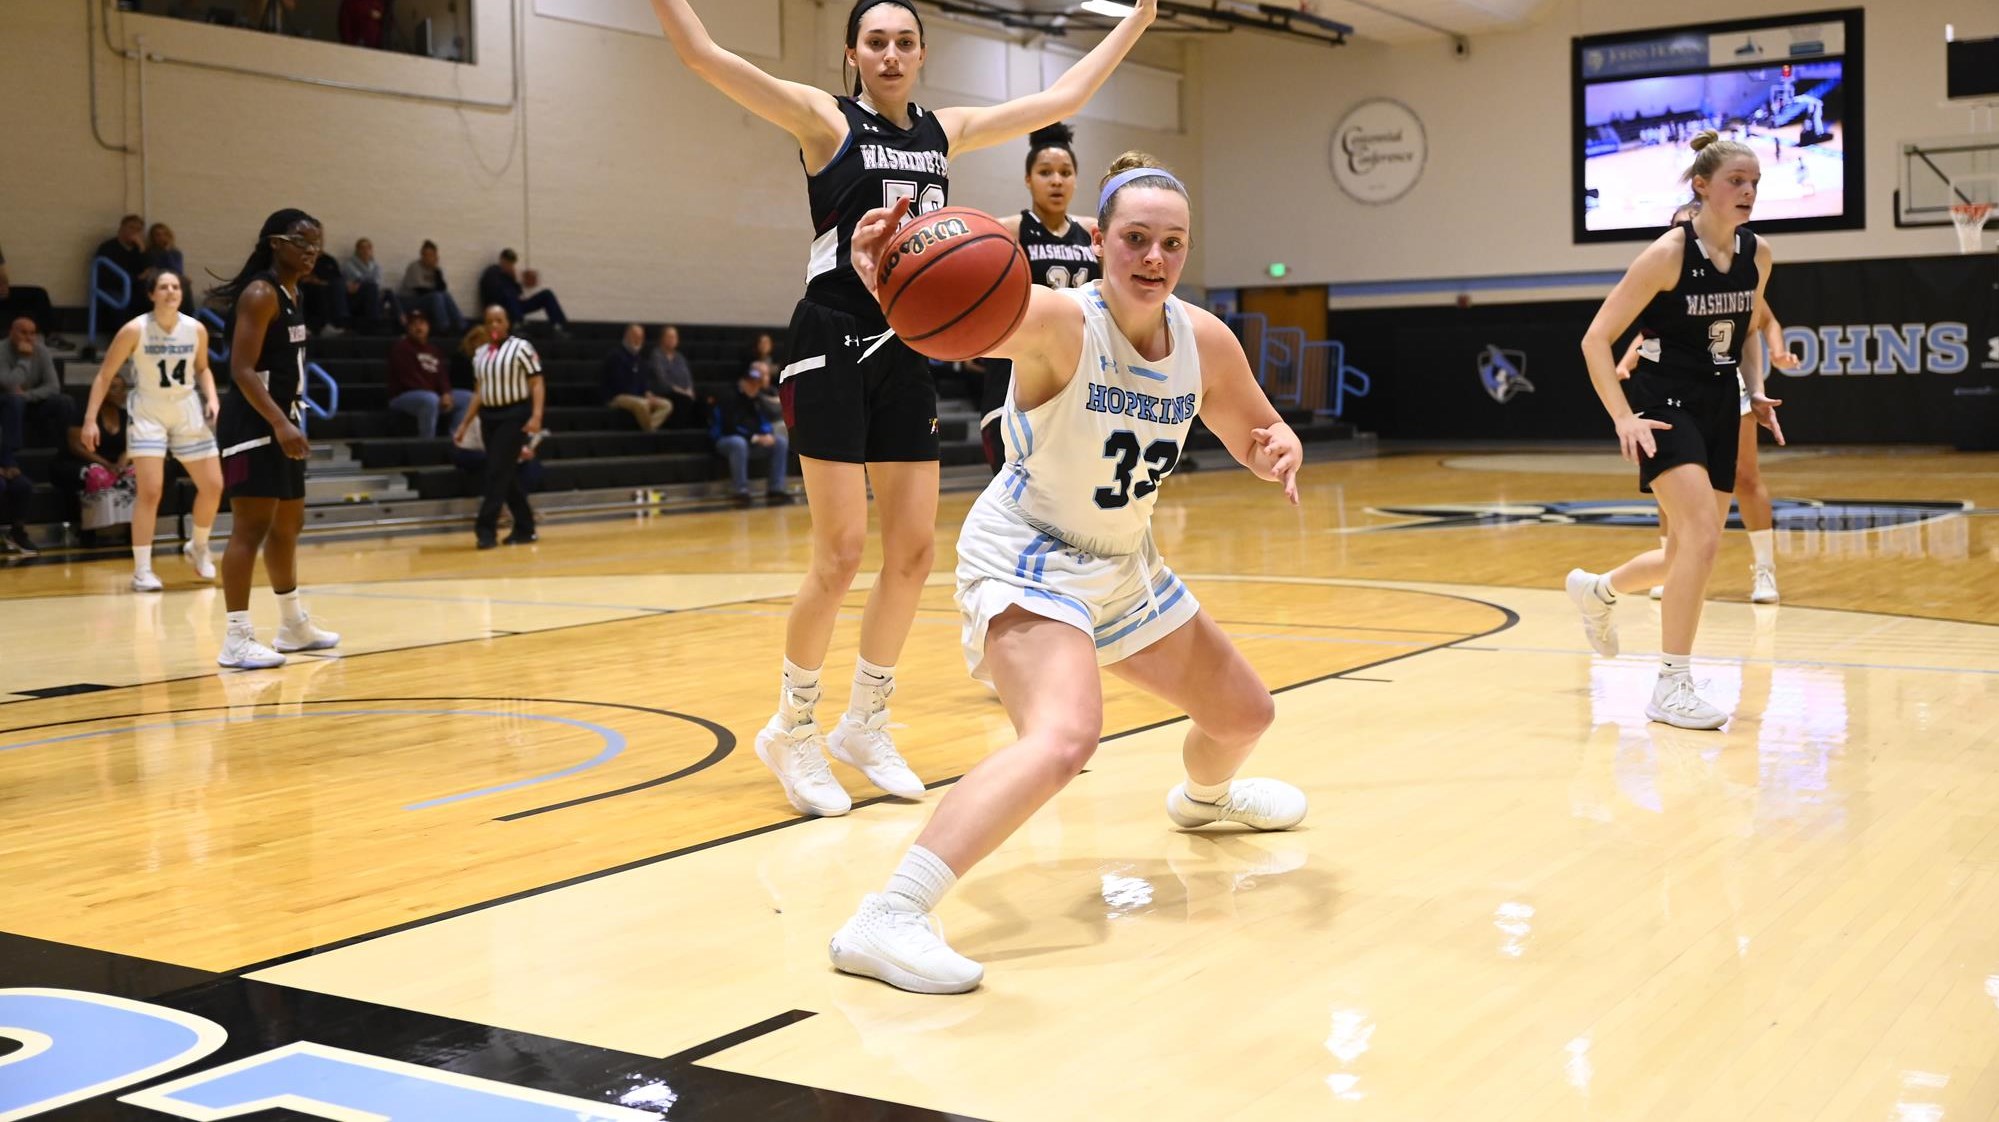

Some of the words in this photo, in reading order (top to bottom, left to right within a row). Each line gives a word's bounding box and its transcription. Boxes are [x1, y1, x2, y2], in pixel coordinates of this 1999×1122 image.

[1707, 319, 1737, 365] 2
[156, 359, 187, 388] 14
[1086, 382, 1196, 425] HOPKINS
[1092, 429, 1181, 511] 33
